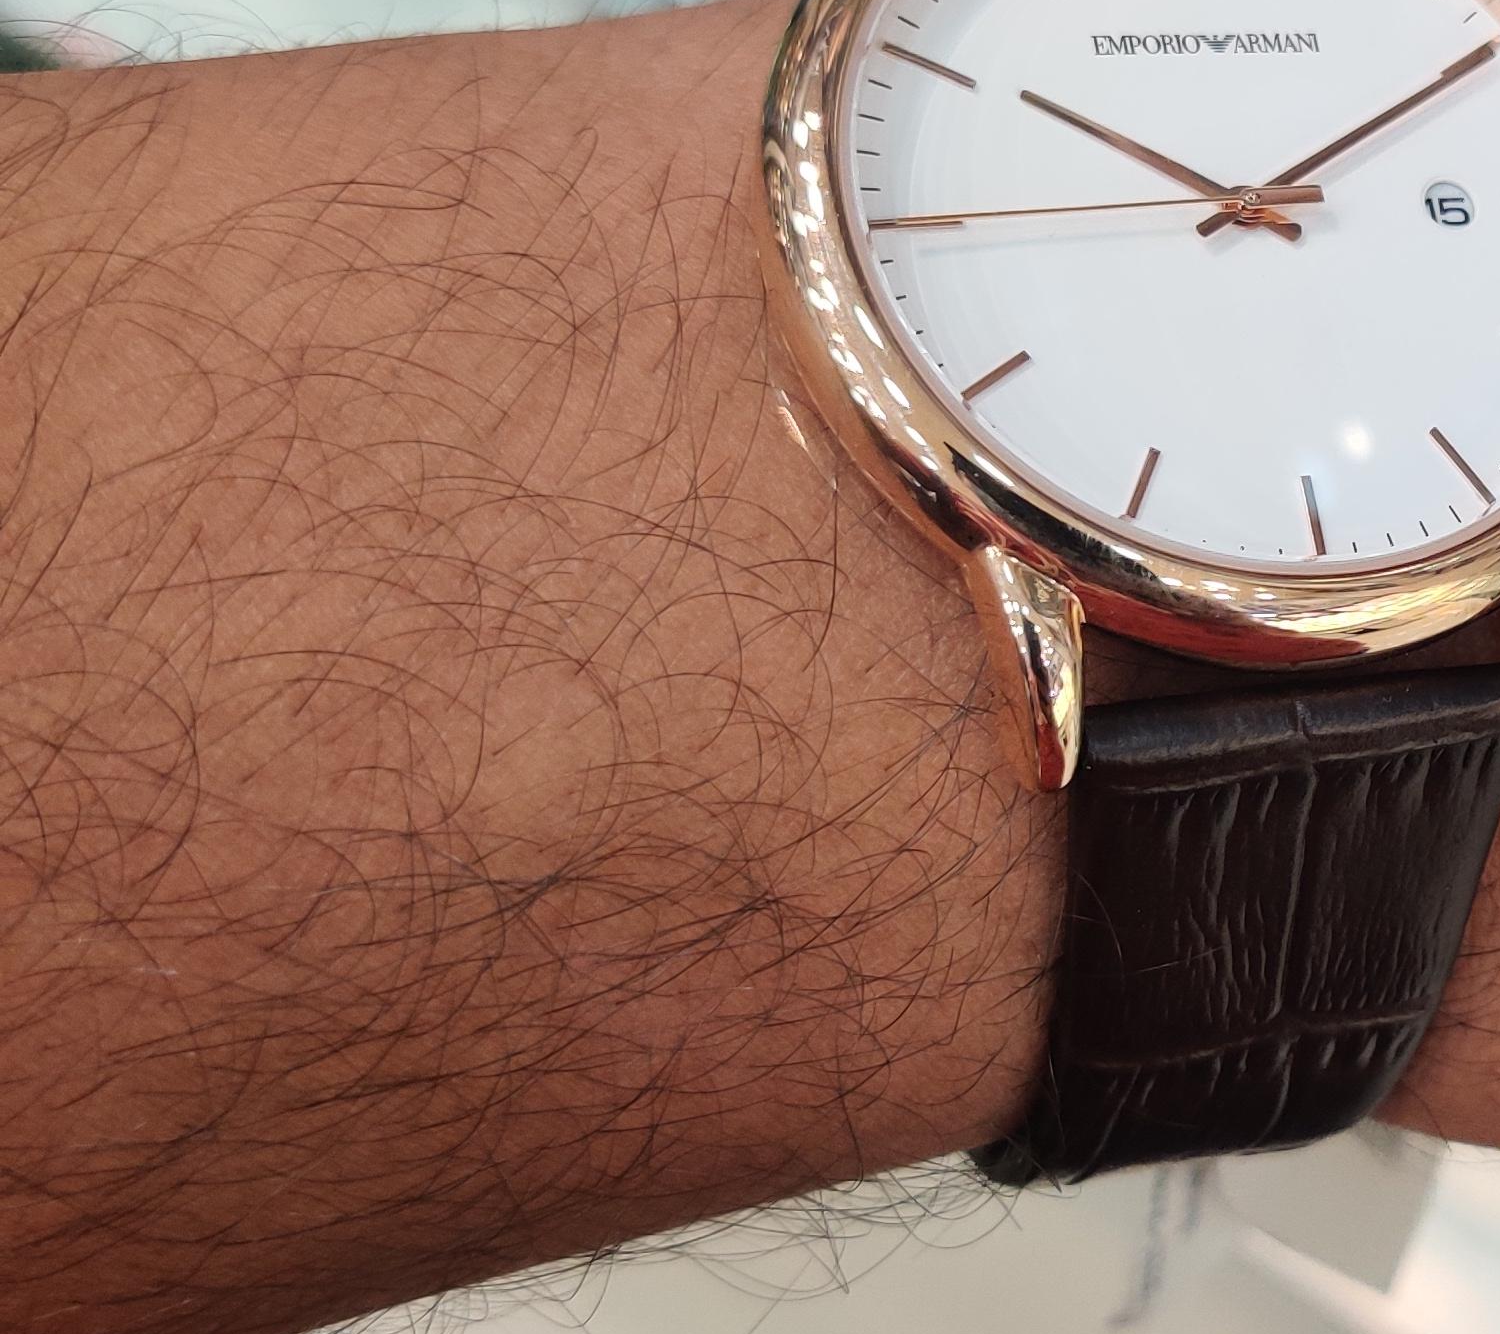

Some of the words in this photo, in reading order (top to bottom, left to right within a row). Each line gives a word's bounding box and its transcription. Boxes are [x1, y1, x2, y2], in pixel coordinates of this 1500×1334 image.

[1091, 34, 1201, 56] EMPORIO
[1234, 33, 1320, 54] ARMANI
[1425, 197, 1470, 226] 15
